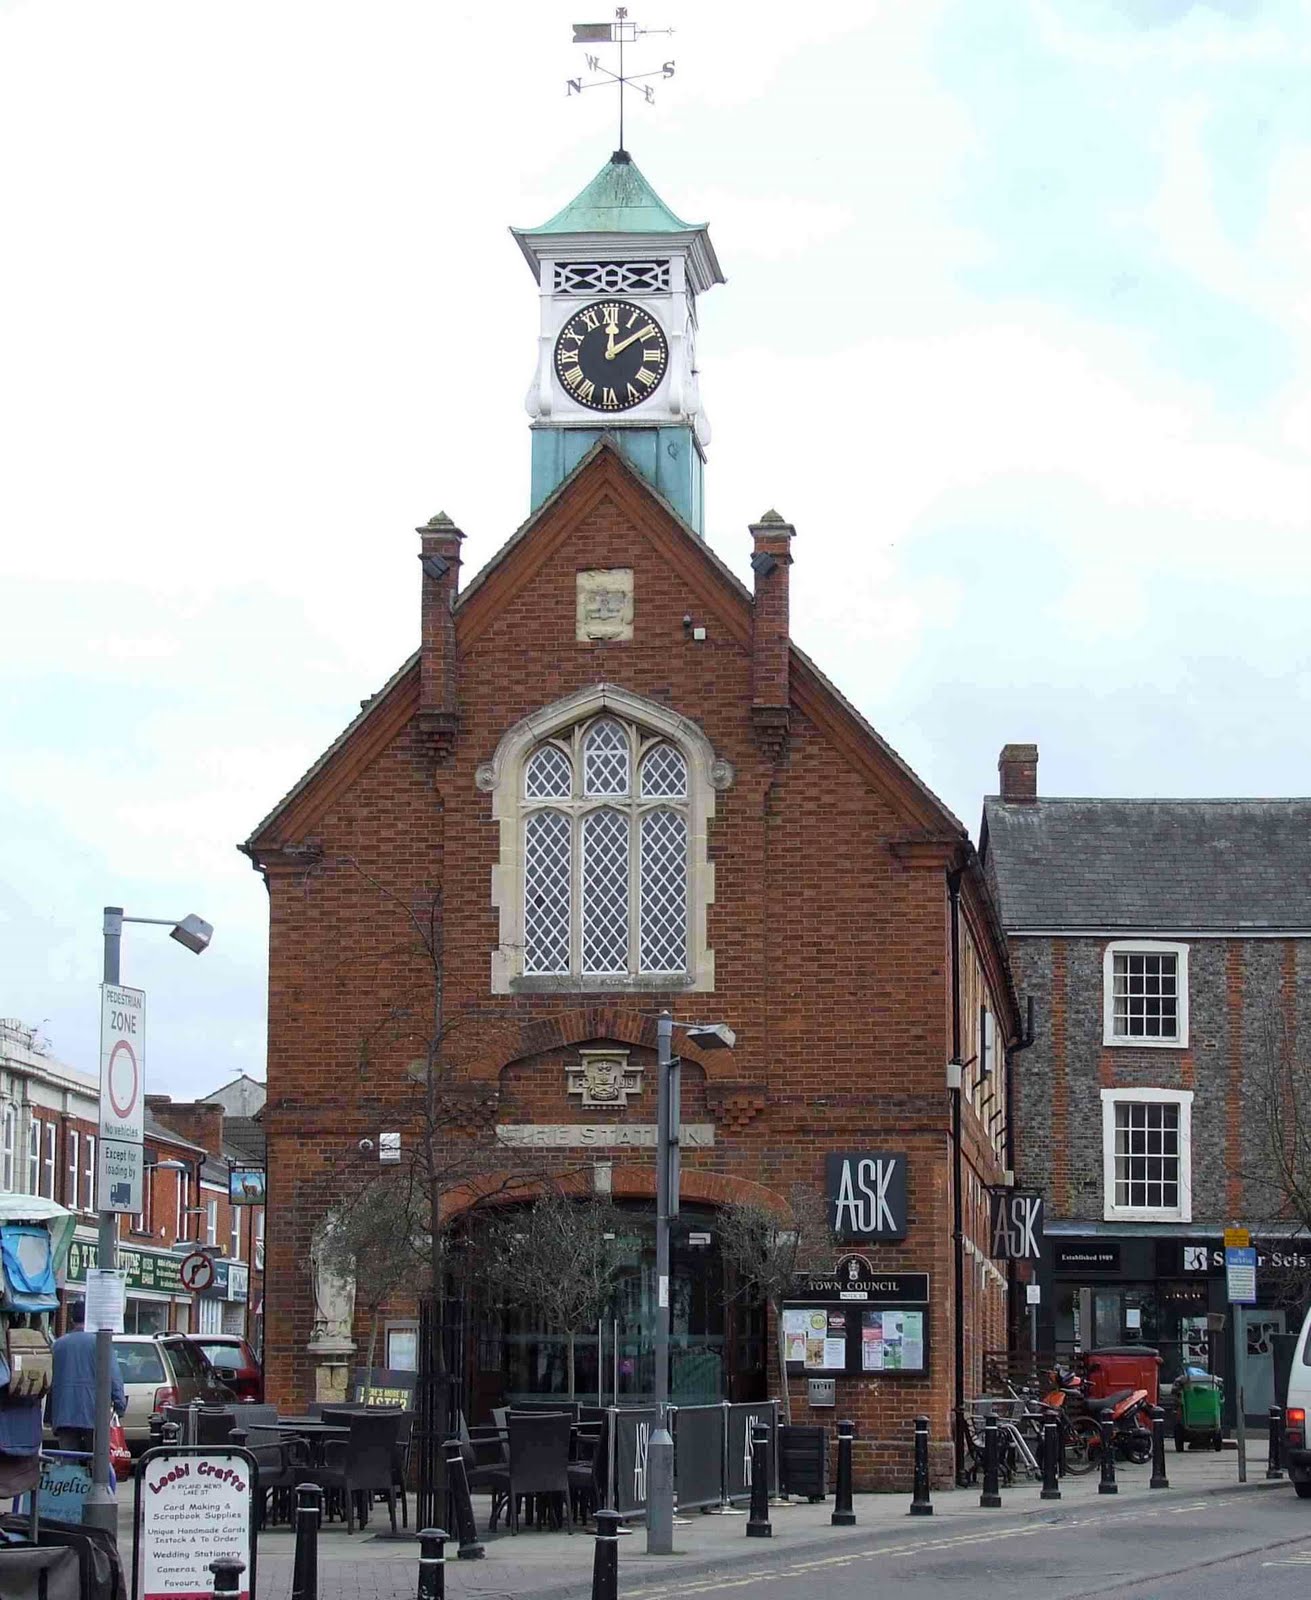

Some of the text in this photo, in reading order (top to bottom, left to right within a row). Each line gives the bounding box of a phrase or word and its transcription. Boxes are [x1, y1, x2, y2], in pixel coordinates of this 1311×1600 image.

[585, 53, 600, 72] W
[662, 60, 675, 80] S
[566, 77, 582, 97] N
[644, 84, 655, 105] E
[581, 311, 600, 332] XI
[626, 312, 639, 329] I
[567, 328, 585, 345] X
[561, 349, 579, 363] IX
[643, 349, 661, 361] III
[602, 388, 619, 404] VI
[627, 382, 640, 401] V
[107, 990, 142, 1009] PEDESTRIAN
[111, 1010, 136, 1034] ZONE
[105, 1122, 138, 1138] No vehicles
[580, 1127, 710, 1145] STATIN.
[106, 1147, 136, 1162] Except for
[106, 1162, 136, 1181] loading by
[835, 1159, 897, 1232] ASK
[992, 1197, 1041, 1258] ASK
[1272, 1252, 1307, 1267] Scis
[809, 1281, 900, 1291] TOWN COUNCIL
[197, 1461, 246, 1492] Crafts
[153, 1512, 242, 1520] Scrapbook Supplies
[189, 1503, 221, 1512] Making
[148, 1526, 246, 1537] Unique Handmade Cards
[153, 1550, 242, 1559] Wedding Stationery
